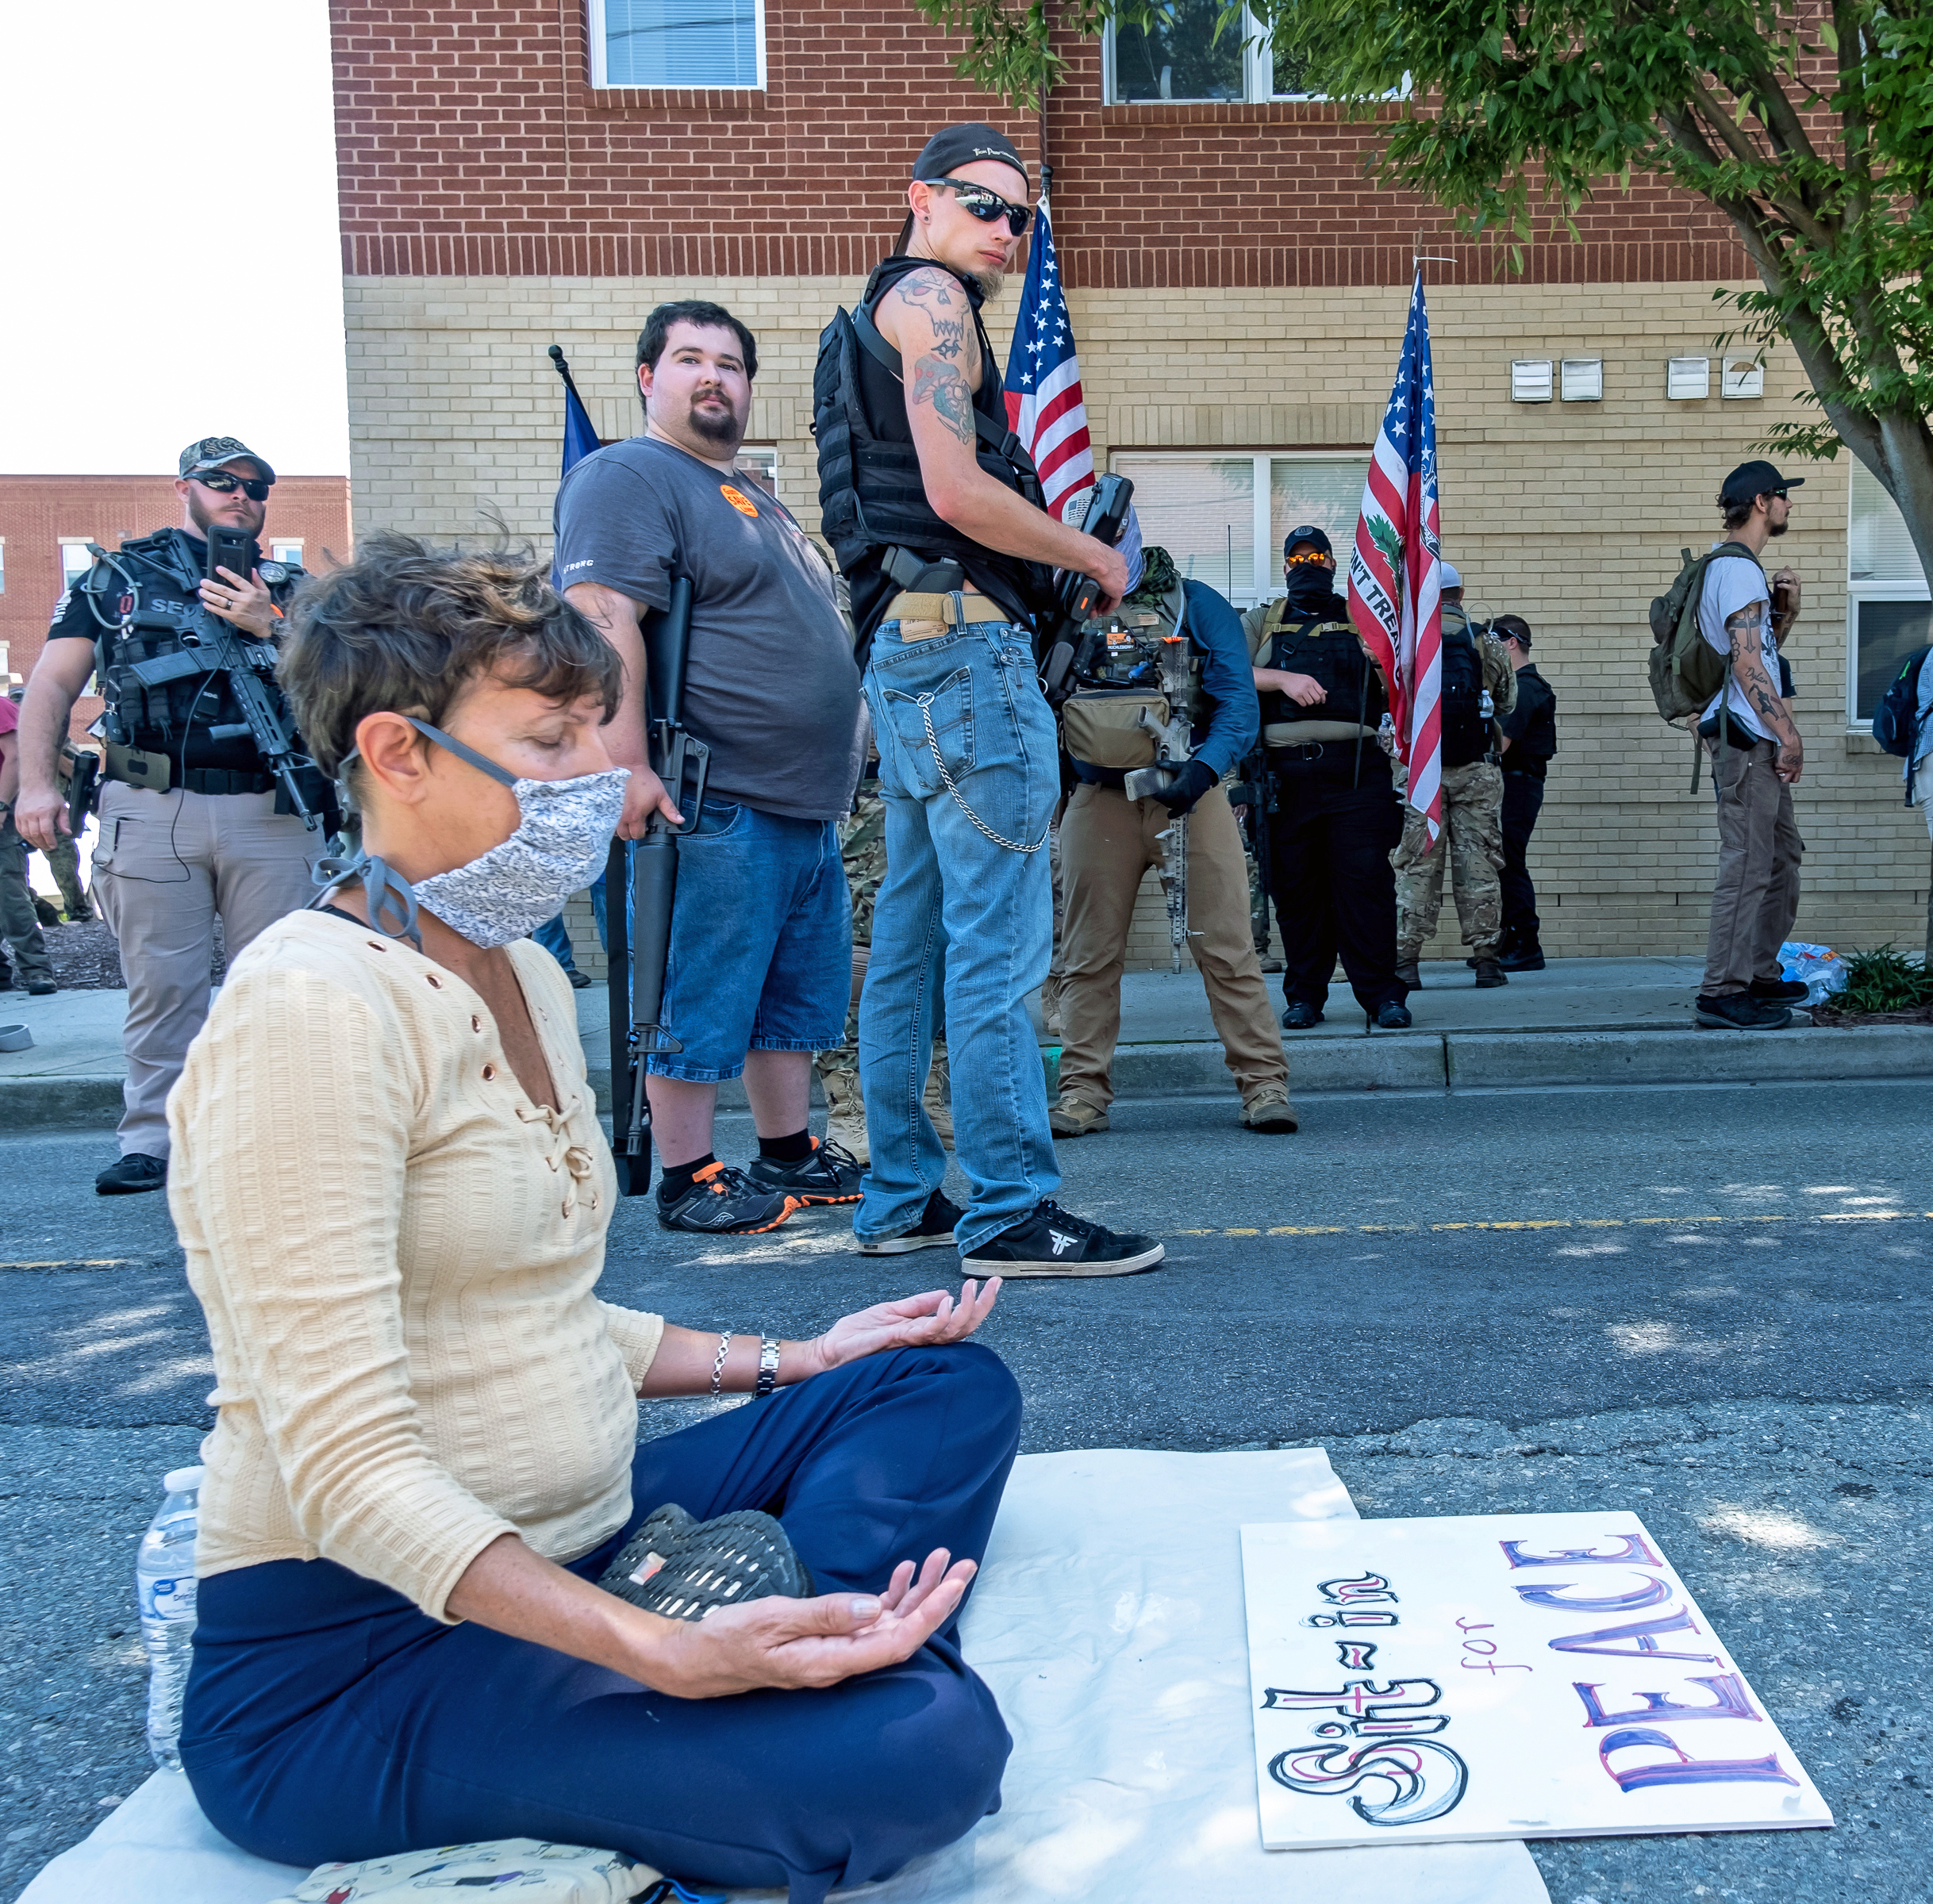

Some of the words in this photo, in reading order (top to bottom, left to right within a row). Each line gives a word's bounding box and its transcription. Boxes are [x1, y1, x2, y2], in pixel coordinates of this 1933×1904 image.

[727, 496, 751, 506] SAVE
[563, 559, 594, 574] STRONG
[1350, 542, 1372, 587] ON'T
[1745, 666, 1769, 685] Dylan
[1455, 1616, 1533, 1676] for
[1498, 1534, 1800, 1793] PEACE
[1259, 1570, 1470, 1827] Sit-in
